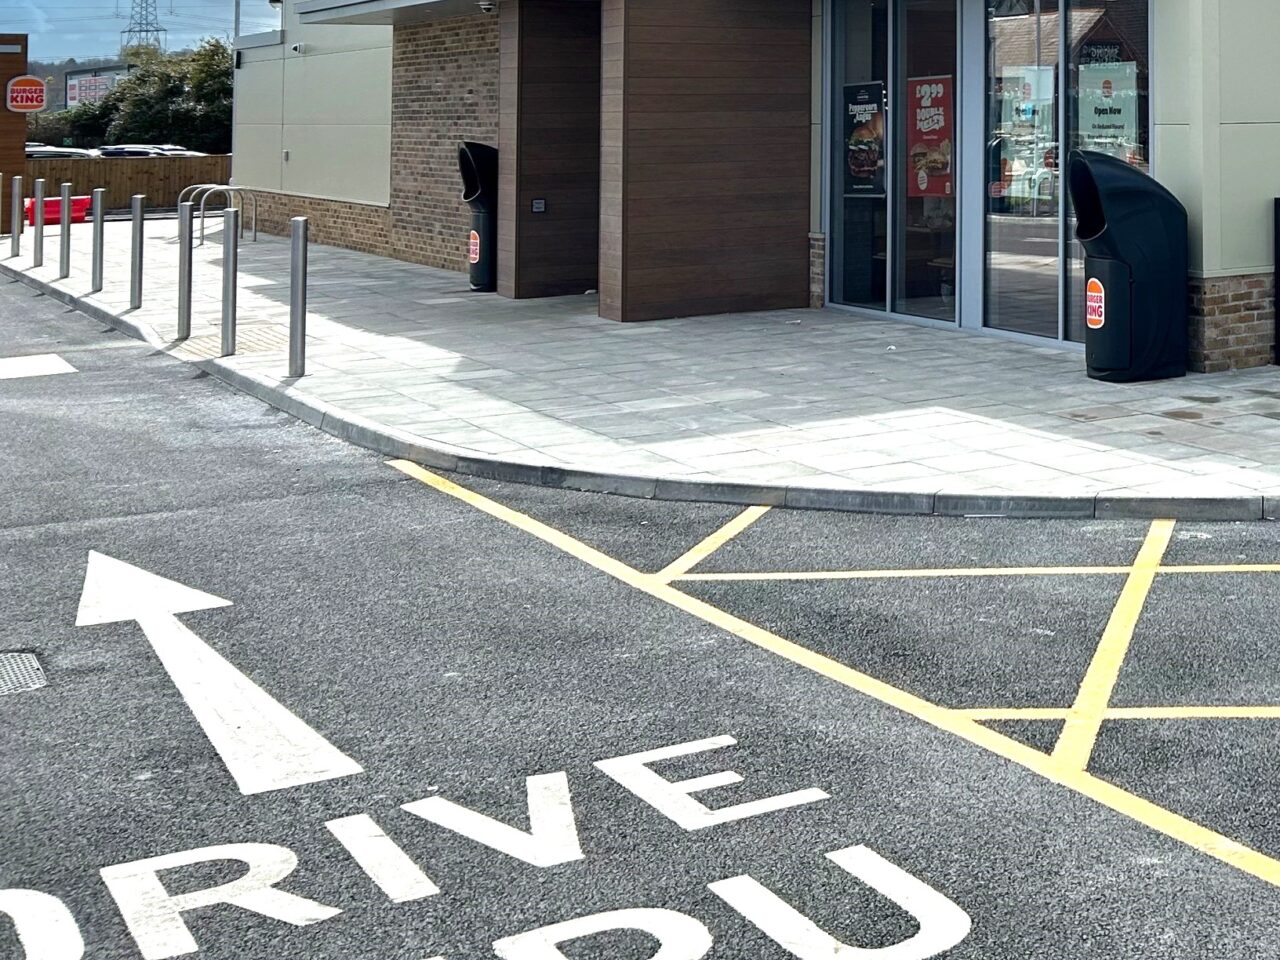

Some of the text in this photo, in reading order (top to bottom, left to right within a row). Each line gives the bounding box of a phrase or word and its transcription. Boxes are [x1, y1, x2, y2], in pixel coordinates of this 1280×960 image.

[10, 87, 44, 95] BURGER
[10, 95, 44, 104] KING
[1094, 106, 1122, 117] Open Now
